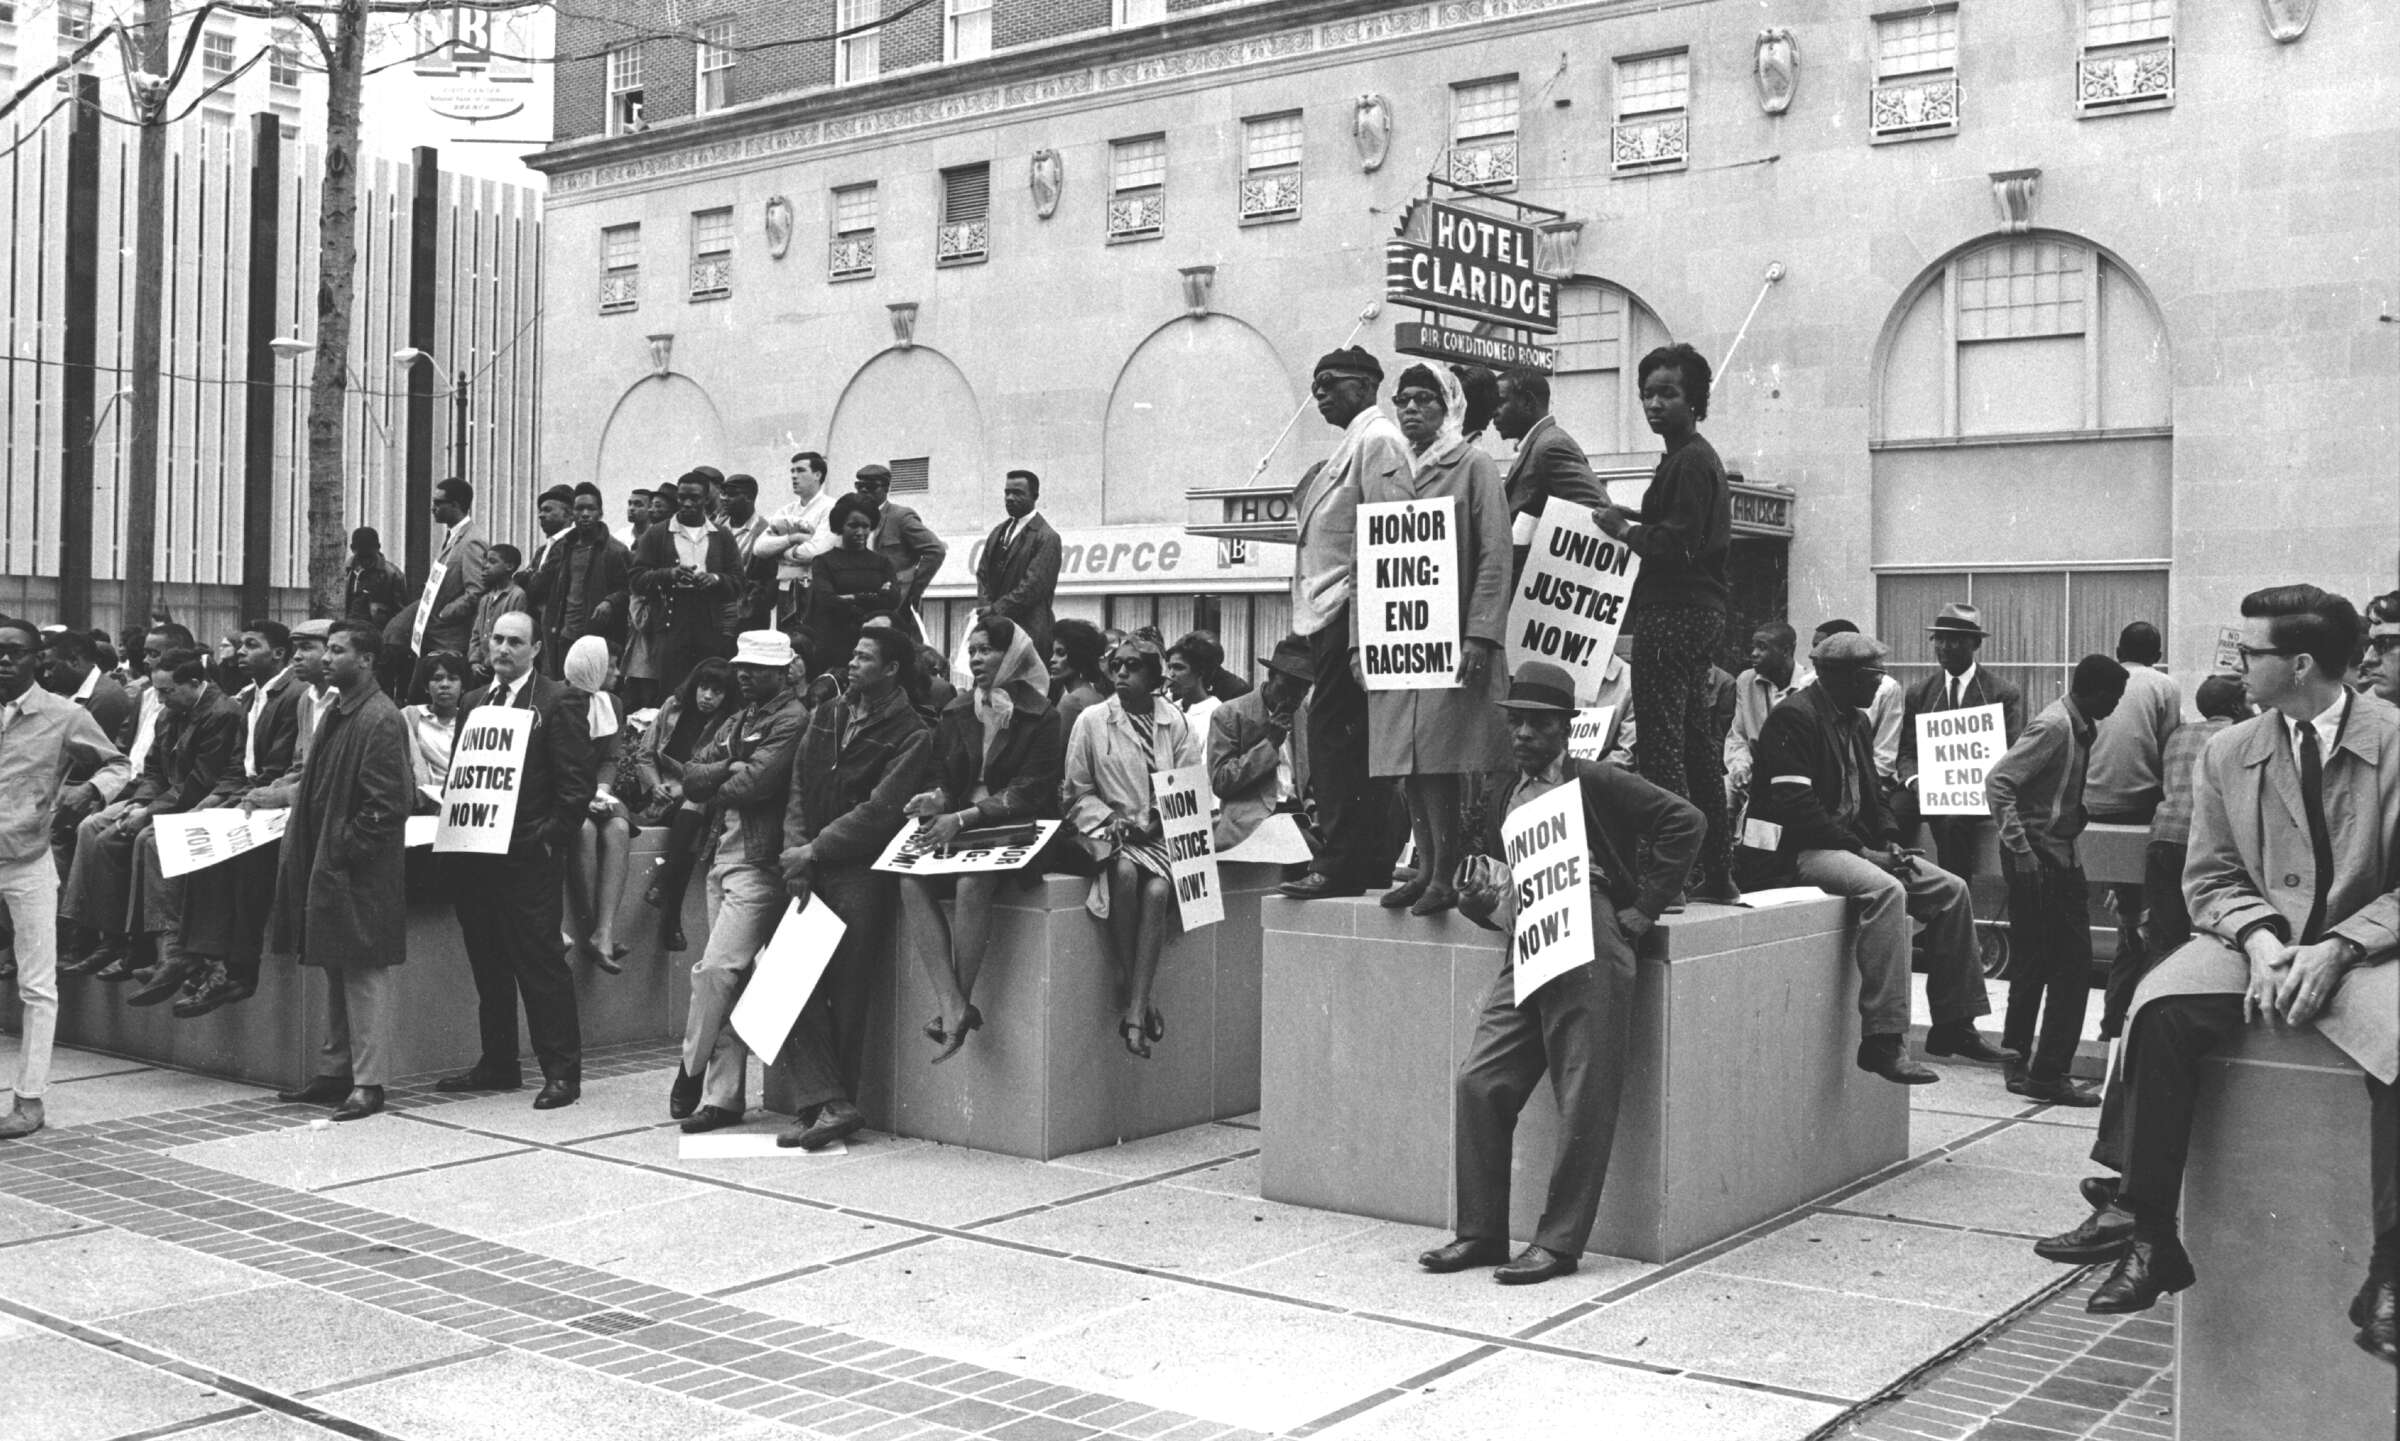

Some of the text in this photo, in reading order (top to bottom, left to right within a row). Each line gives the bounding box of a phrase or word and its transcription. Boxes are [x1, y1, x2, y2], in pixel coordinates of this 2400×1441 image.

[1438, 211, 1529, 268] HOTEL
[1411, 253, 1551, 318] CLARIDGE
[1420, 326, 1553, 369] AIR CONDITIONED ROOMS
[1369, 510, 1446, 546] HONOR
[968, 539, 1182, 576] Cmerce
[1549, 525, 1633, 577] UNION
[1376, 555, 1439, 589] KING:
[1524, 572, 1624, 625] JUSTICE
[1385, 600, 1429, 632] END
[1366, 642, 1454, 675] RACISM!
[1521, 618, 1597, 667] NOW!
[462, 727, 514, 751] UNION
[1927, 713, 1994, 738] HONOR
[1935, 741, 1990, 762] KING:
[449, 765, 516, 791] JUSTICE
[1945, 768, 1983, 785] END
[448, 802, 499, 828] NOW!
[1927, 791, 1988, 806] RACIS
[1508, 811, 1567, 871] UNION
[1177, 871, 1208, 903] NOW!
[1518, 907, 1571, 965] NOW!
